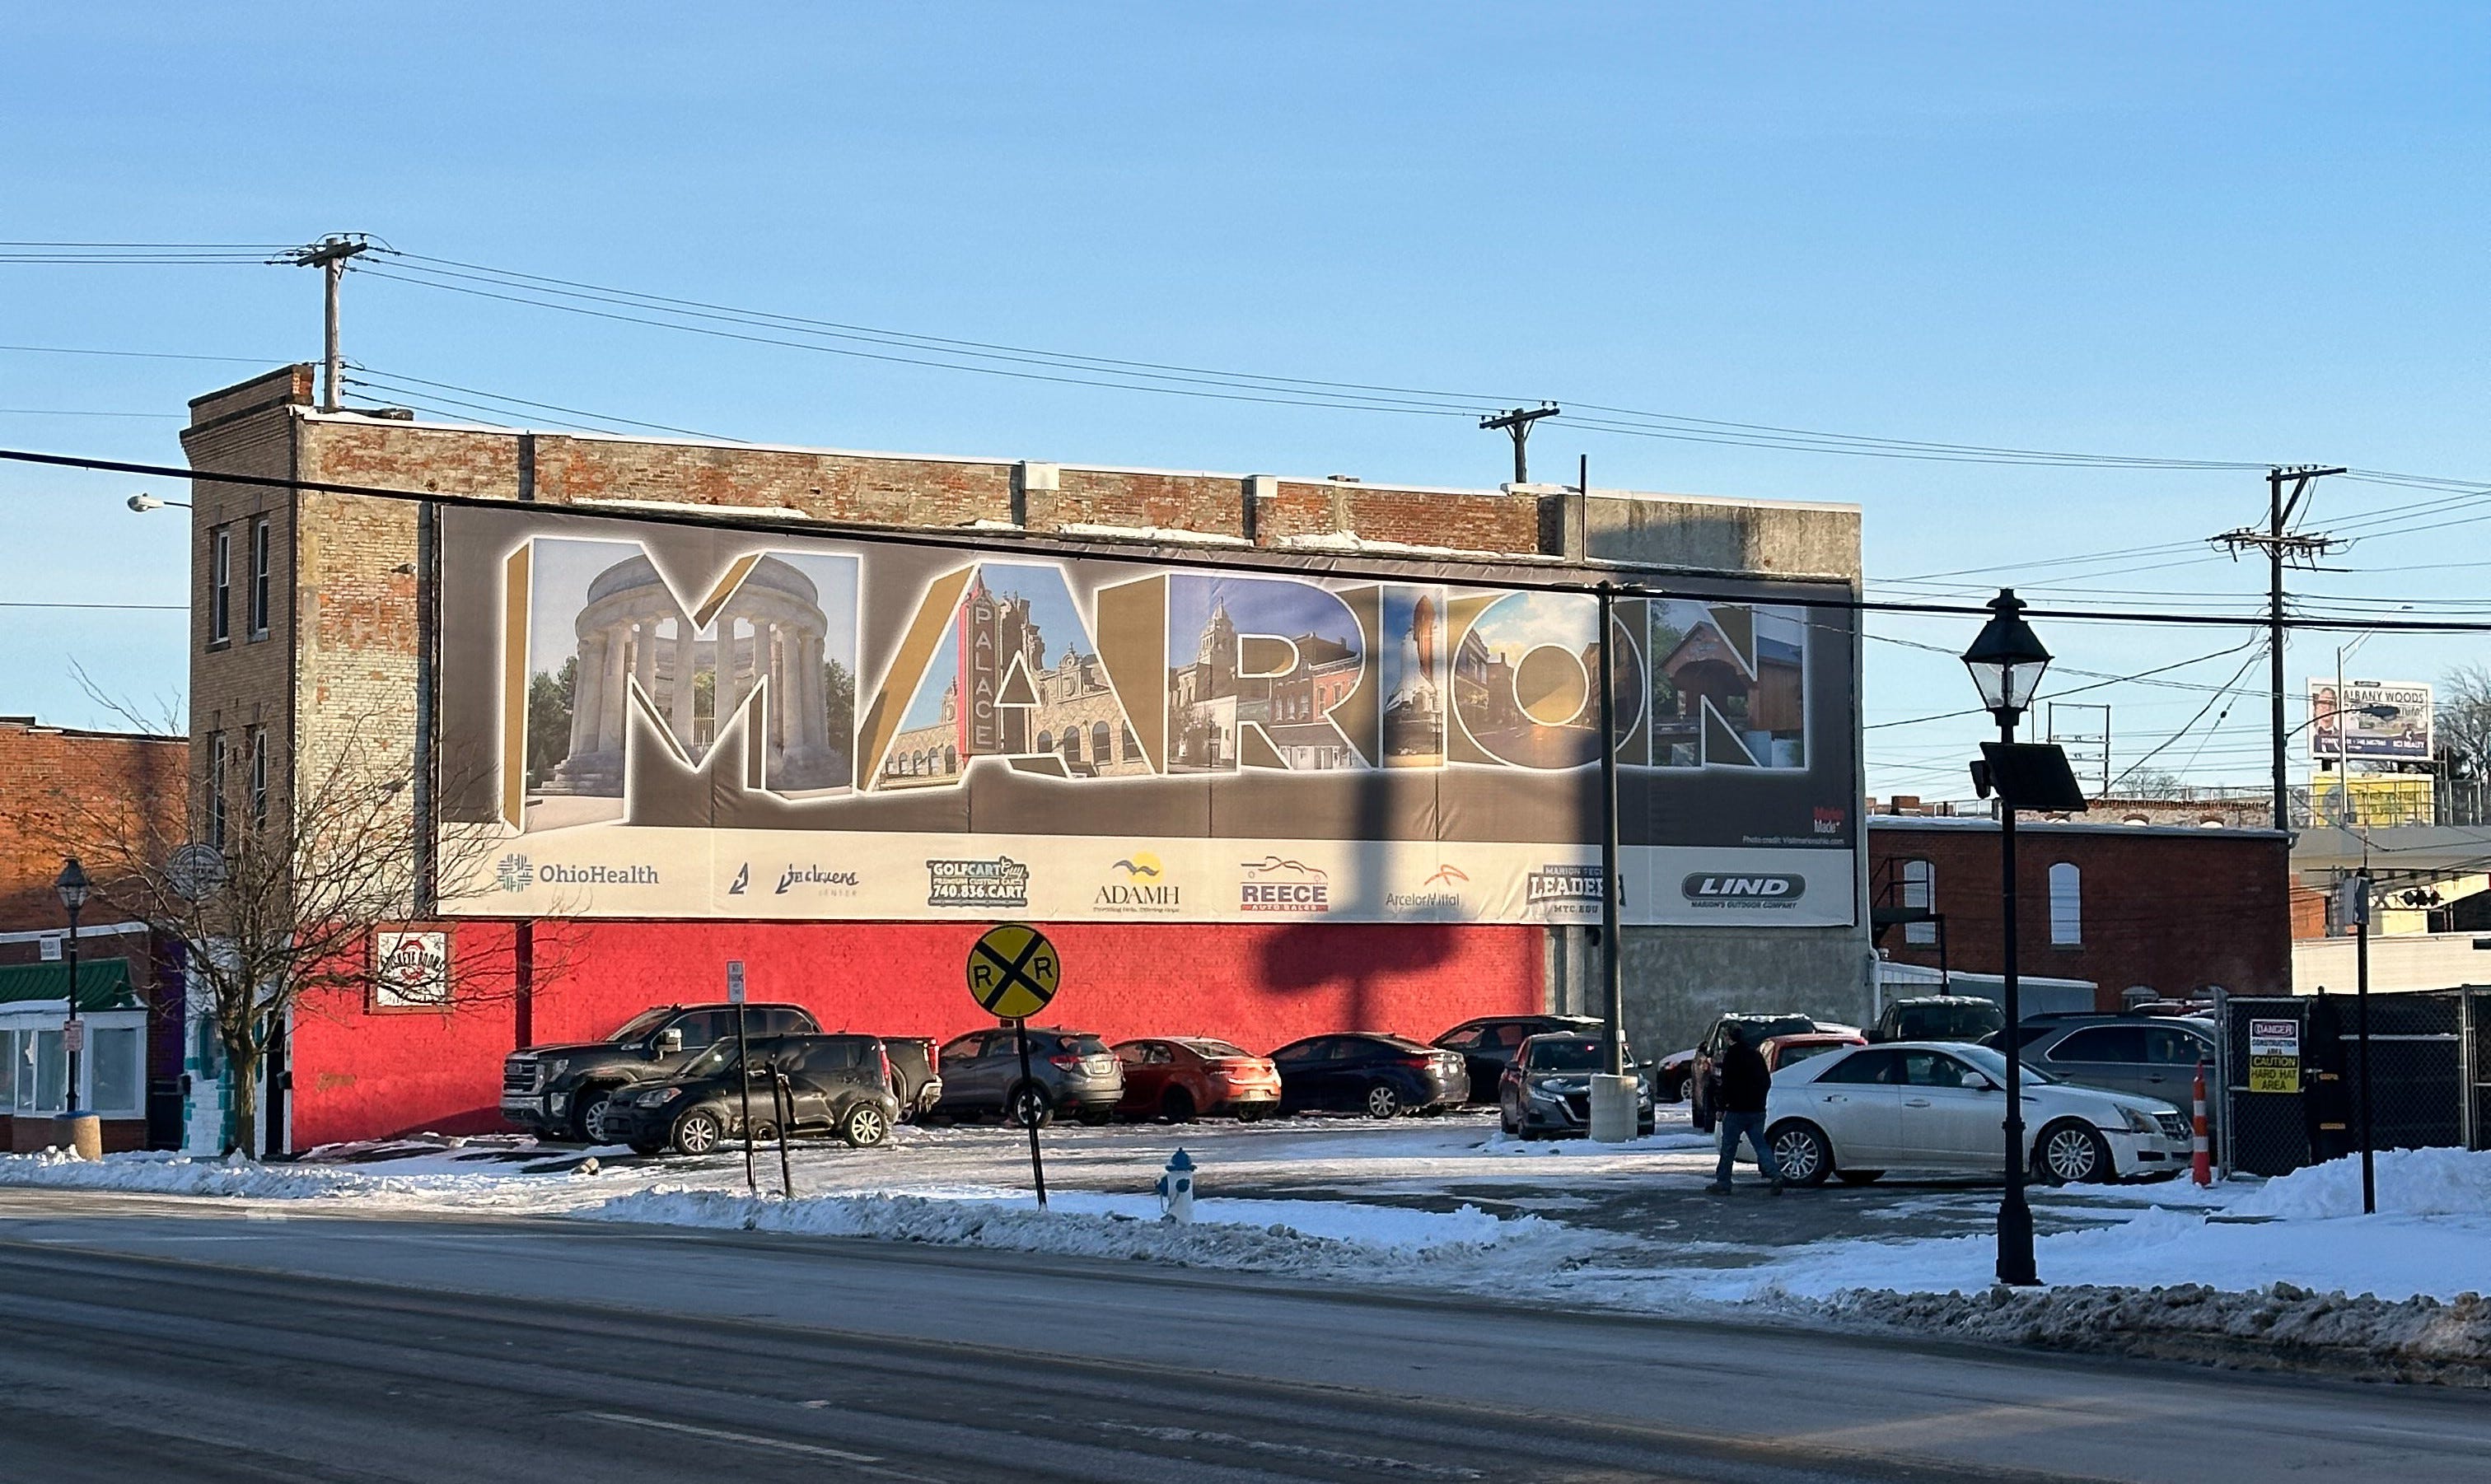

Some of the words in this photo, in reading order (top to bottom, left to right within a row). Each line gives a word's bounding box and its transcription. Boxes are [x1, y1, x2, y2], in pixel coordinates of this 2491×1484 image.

[974, 605, 995, 745] PALACE
[498, 534, 1812, 835] MARION
[2344, 690, 2382, 702] ALBANY
[2386, 693, 2423, 703] WOODS
[540, 865, 660, 884] OhioHealth
[1545, 866, 1581, 875] MARION
[932, 884, 1024, 898] 740.836.CART
[1699, 878, 1790, 895] LIND
[1094, 884, 1180, 904] ADAMH
[1241, 885, 1327, 903] REECE
[1386, 893, 1460, 907] ArcelorMittal
[973, 964, 993, 988] R
[1033, 956, 1054, 980] R
[2257, 1025, 2292, 1034] DANGER
[2254, 1057, 2296, 1066] CAUTION
[2251, 1069, 2276, 1079] HARD
[2279, 1070, 2297, 1079] HAT
[2261, 1080, 2287, 1090] AREA
